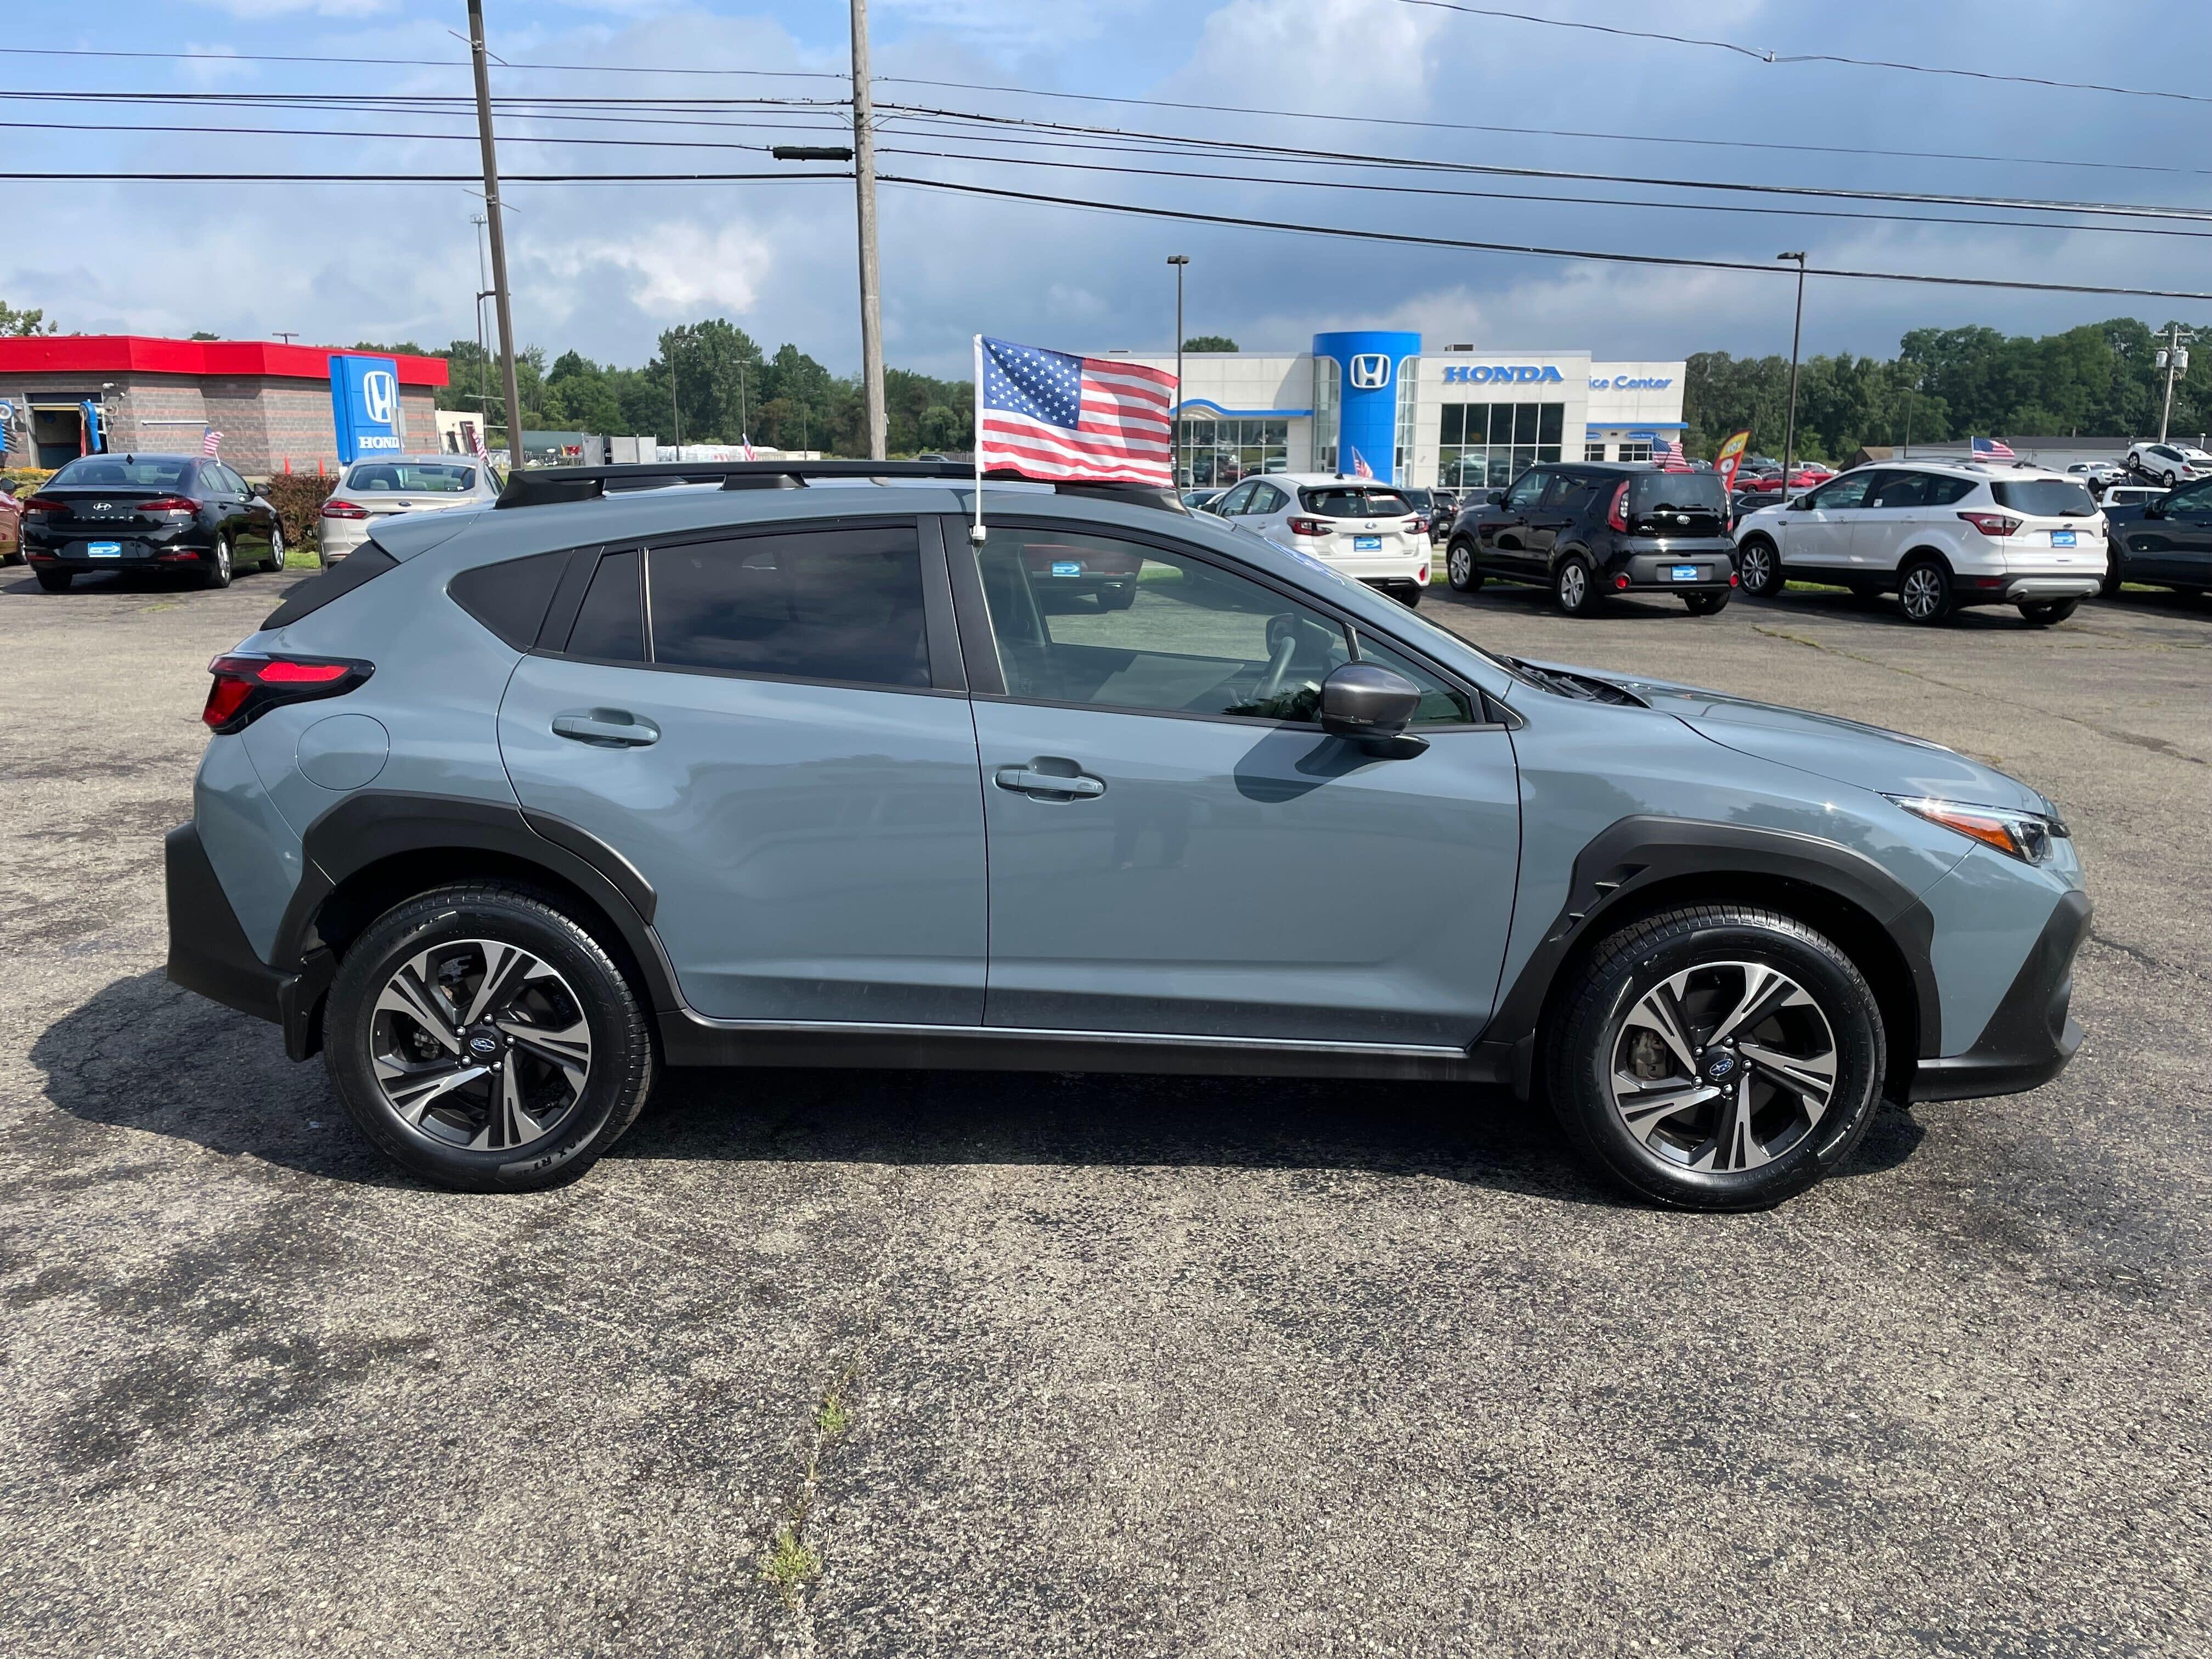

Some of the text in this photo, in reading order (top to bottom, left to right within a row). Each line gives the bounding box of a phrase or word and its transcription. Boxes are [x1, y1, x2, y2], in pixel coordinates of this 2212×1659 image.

[1444, 366, 1564, 382] HONDA
[1615, 375, 1673, 389] Center
[358, 436, 405, 449] HOND
